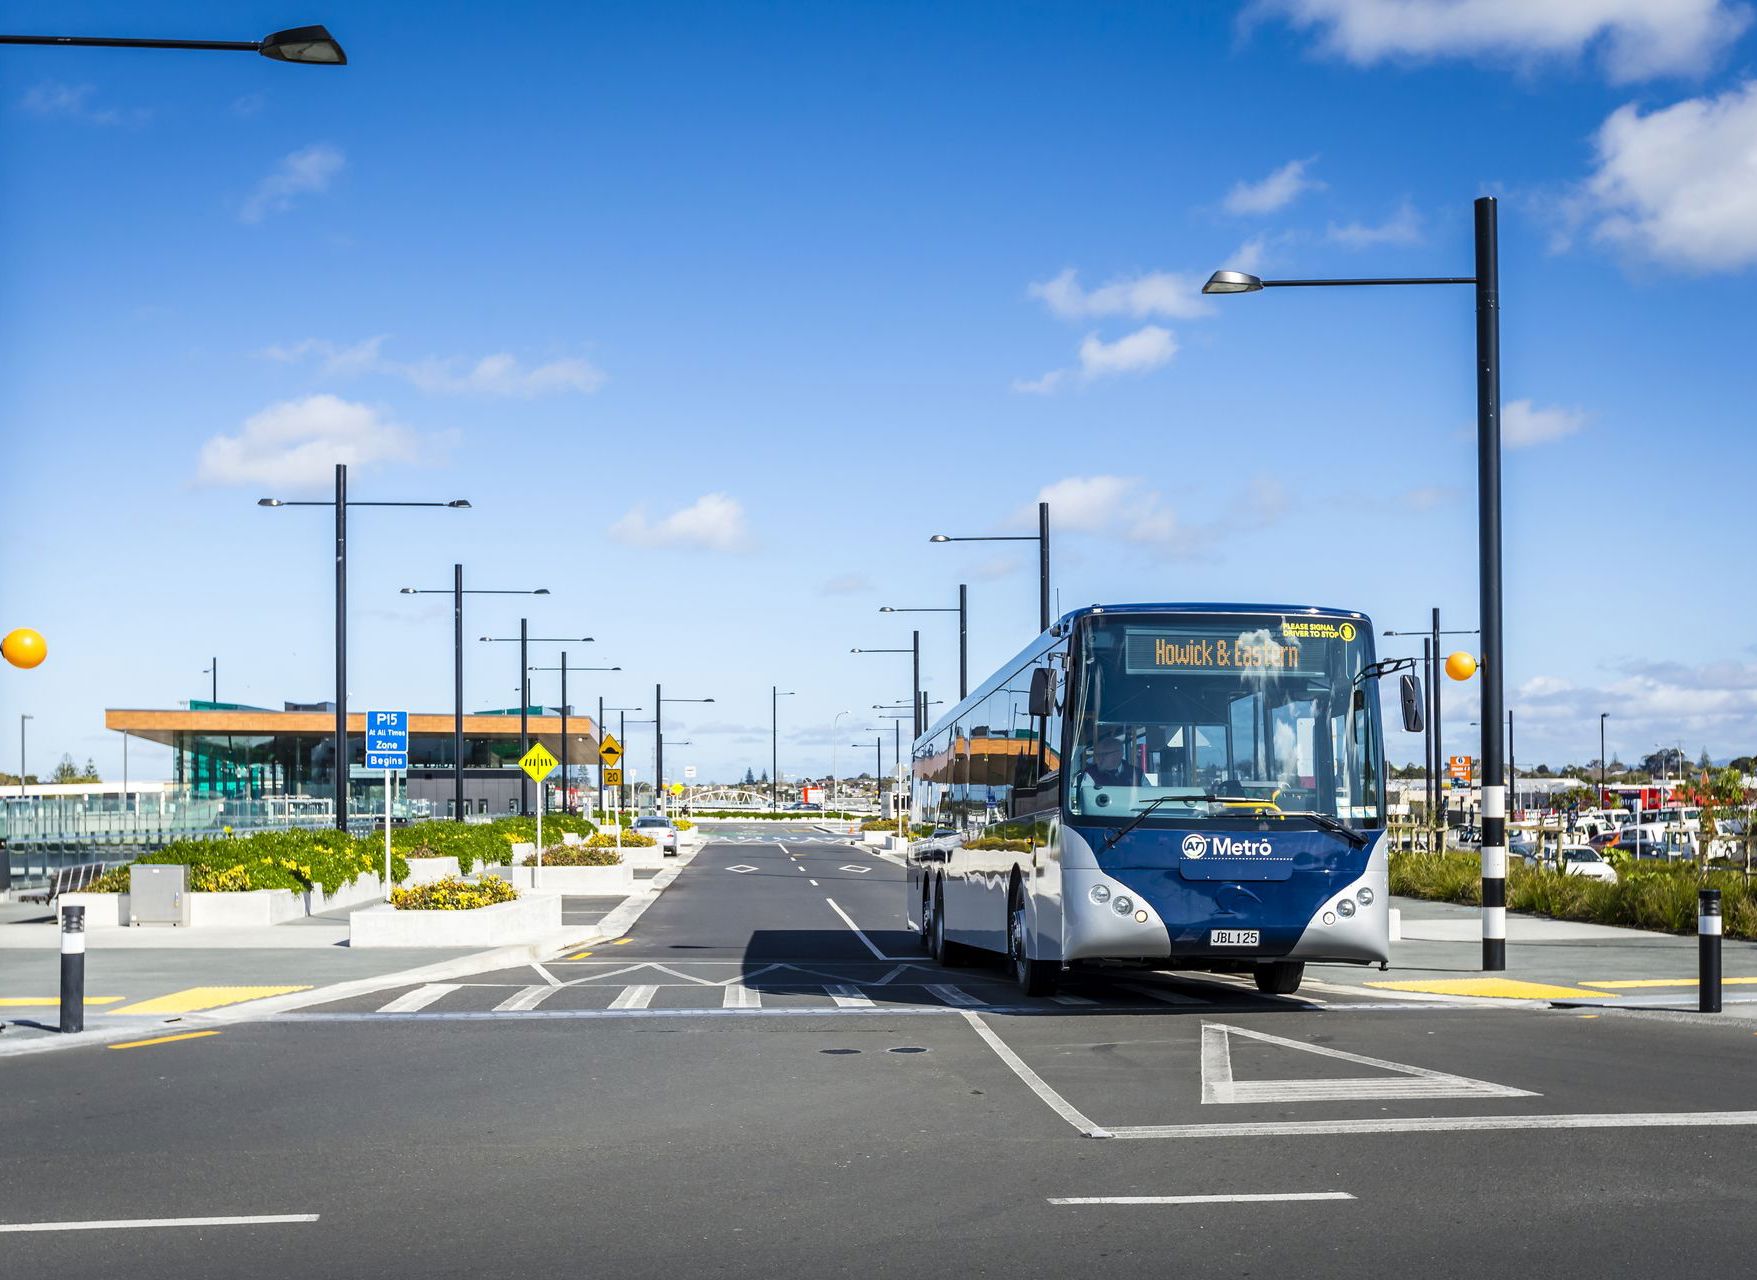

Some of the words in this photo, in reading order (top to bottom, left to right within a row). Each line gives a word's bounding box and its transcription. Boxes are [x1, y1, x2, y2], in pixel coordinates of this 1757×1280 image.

[1155, 639, 1213, 666] Howick
[1217, 640, 1230, 666] &
[1234, 640, 1298, 667] Eastern
[377, 713, 398, 725] P15
[388, 729, 405, 737] Times
[376, 740, 397, 749] Zone
[370, 756, 402, 767] Begins
[608, 773, 618, 782] 20
[1213, 932, 1257, 943] JBL125
